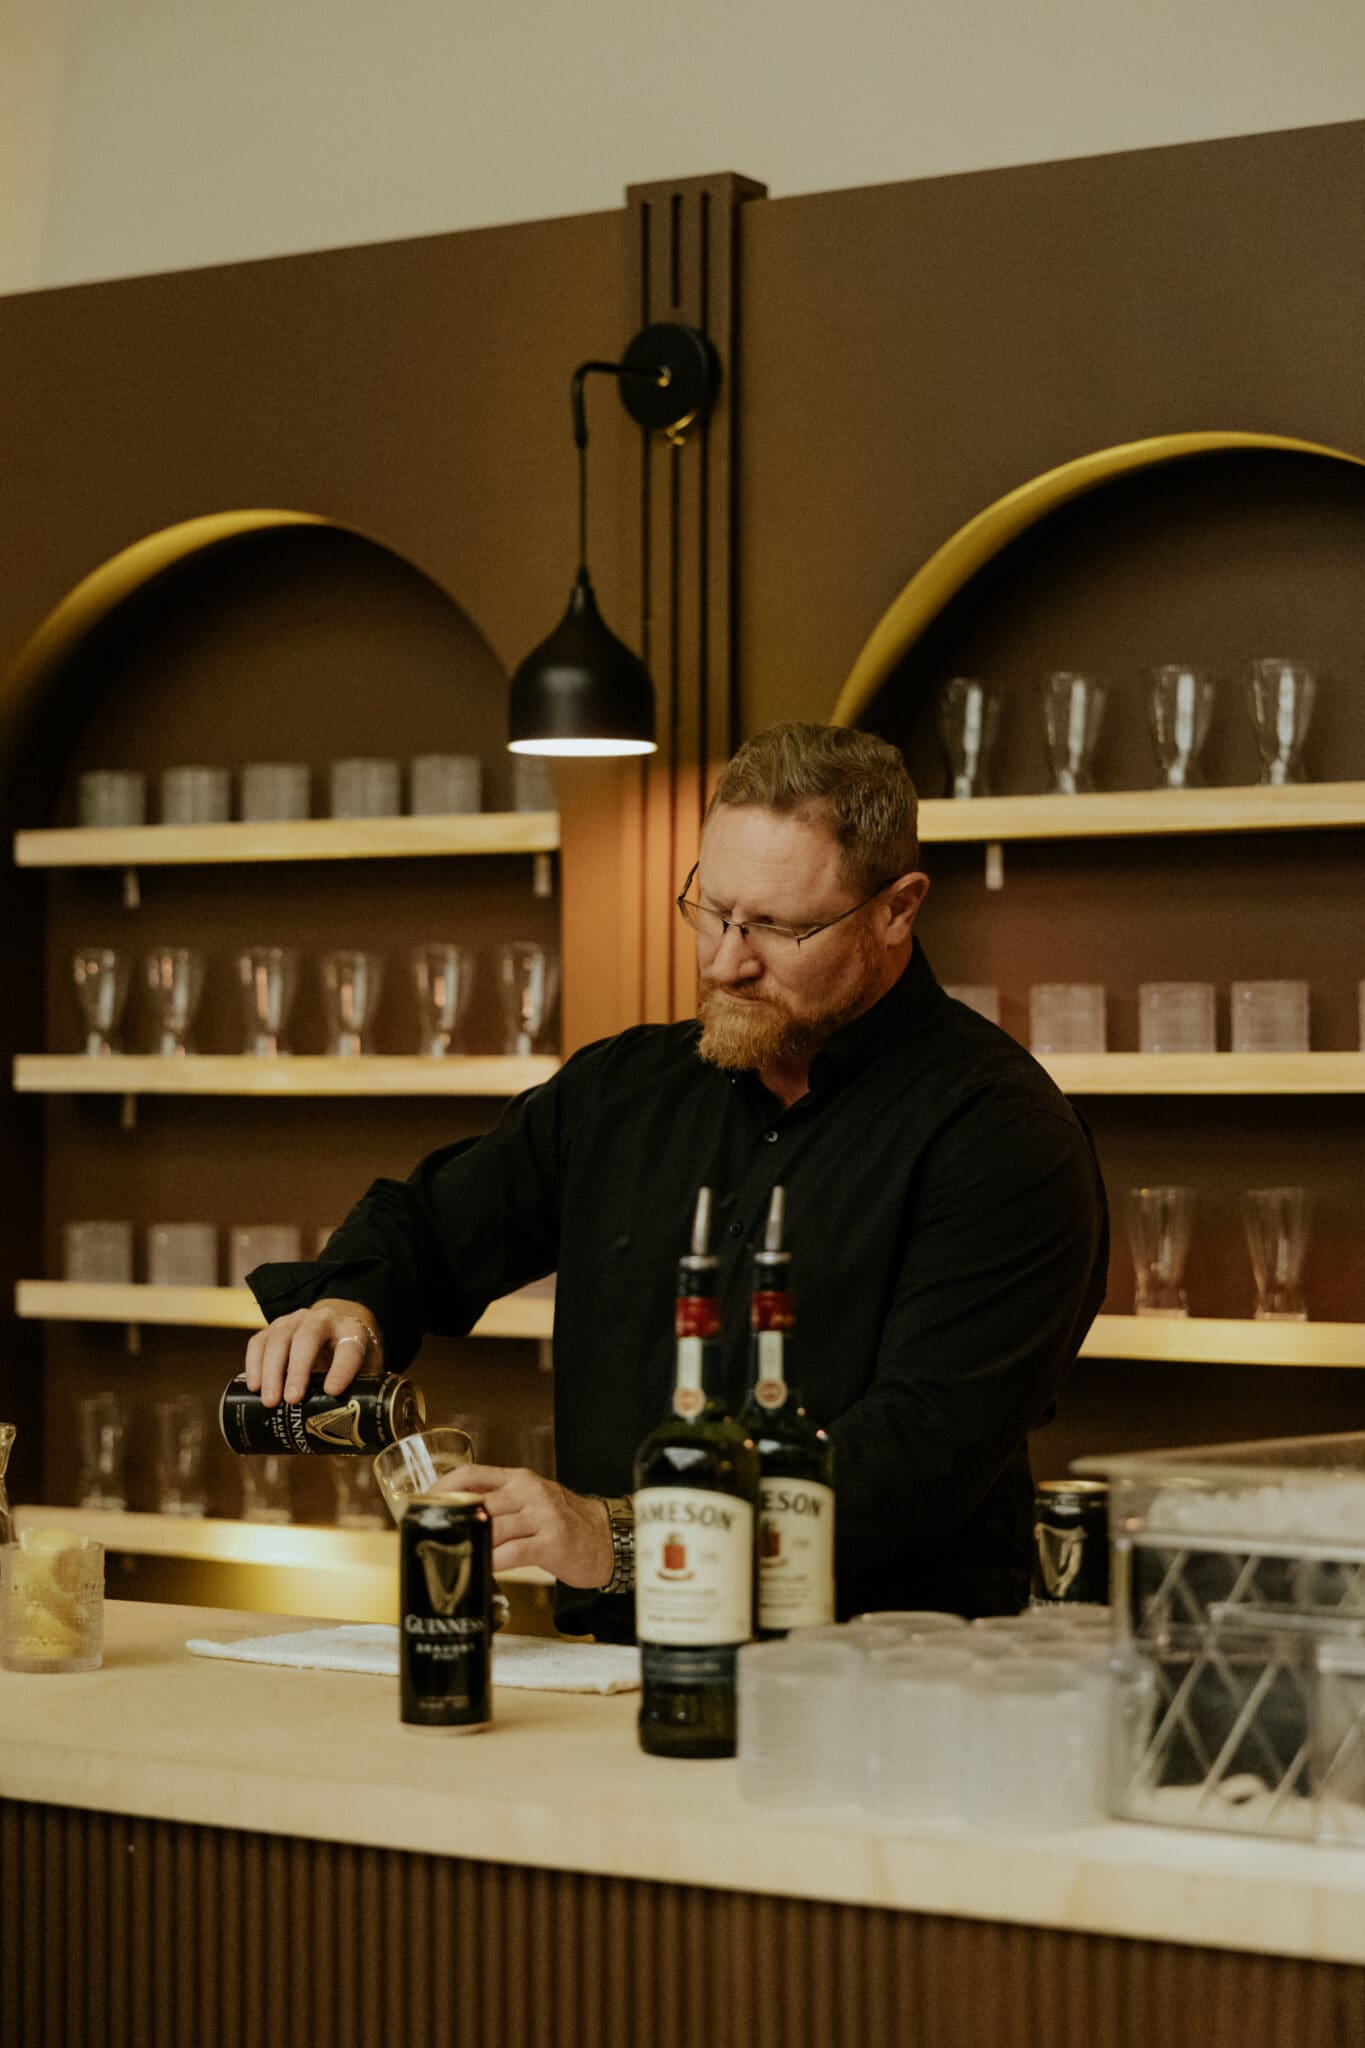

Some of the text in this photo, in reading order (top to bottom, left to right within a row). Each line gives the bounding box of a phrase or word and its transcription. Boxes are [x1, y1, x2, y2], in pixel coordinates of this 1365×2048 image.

[277, 1402, 292, 1449] RAUGHT
[638, 1500, 732, 1532] AMESON
[759, 1492, 821, 1517] ESON
